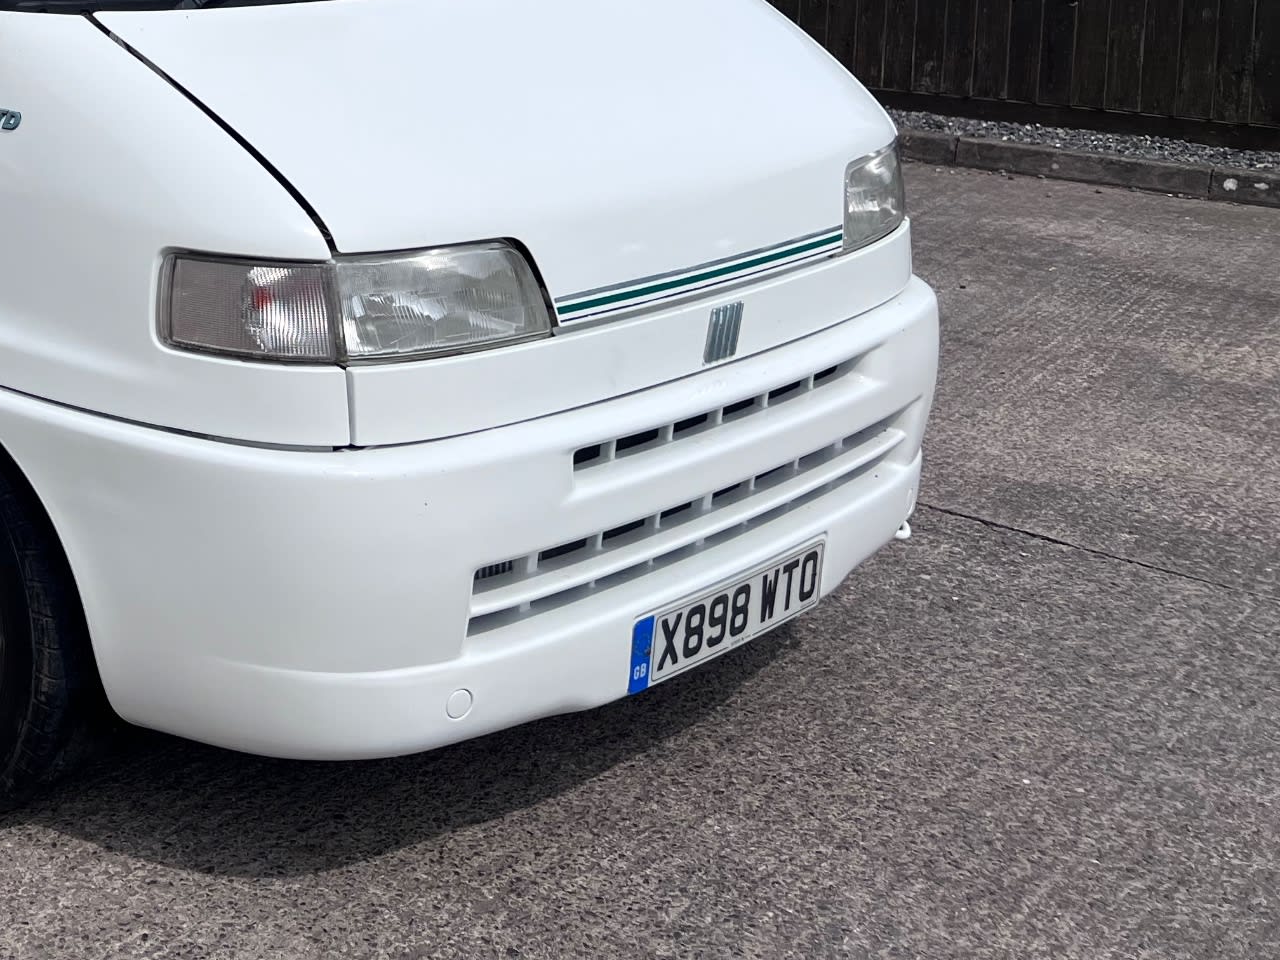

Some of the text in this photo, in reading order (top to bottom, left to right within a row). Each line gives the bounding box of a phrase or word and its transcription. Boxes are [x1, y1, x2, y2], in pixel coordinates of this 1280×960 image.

[656, 550, 819, 671] X898 WTO
[633, 663, 647, 679] GB
